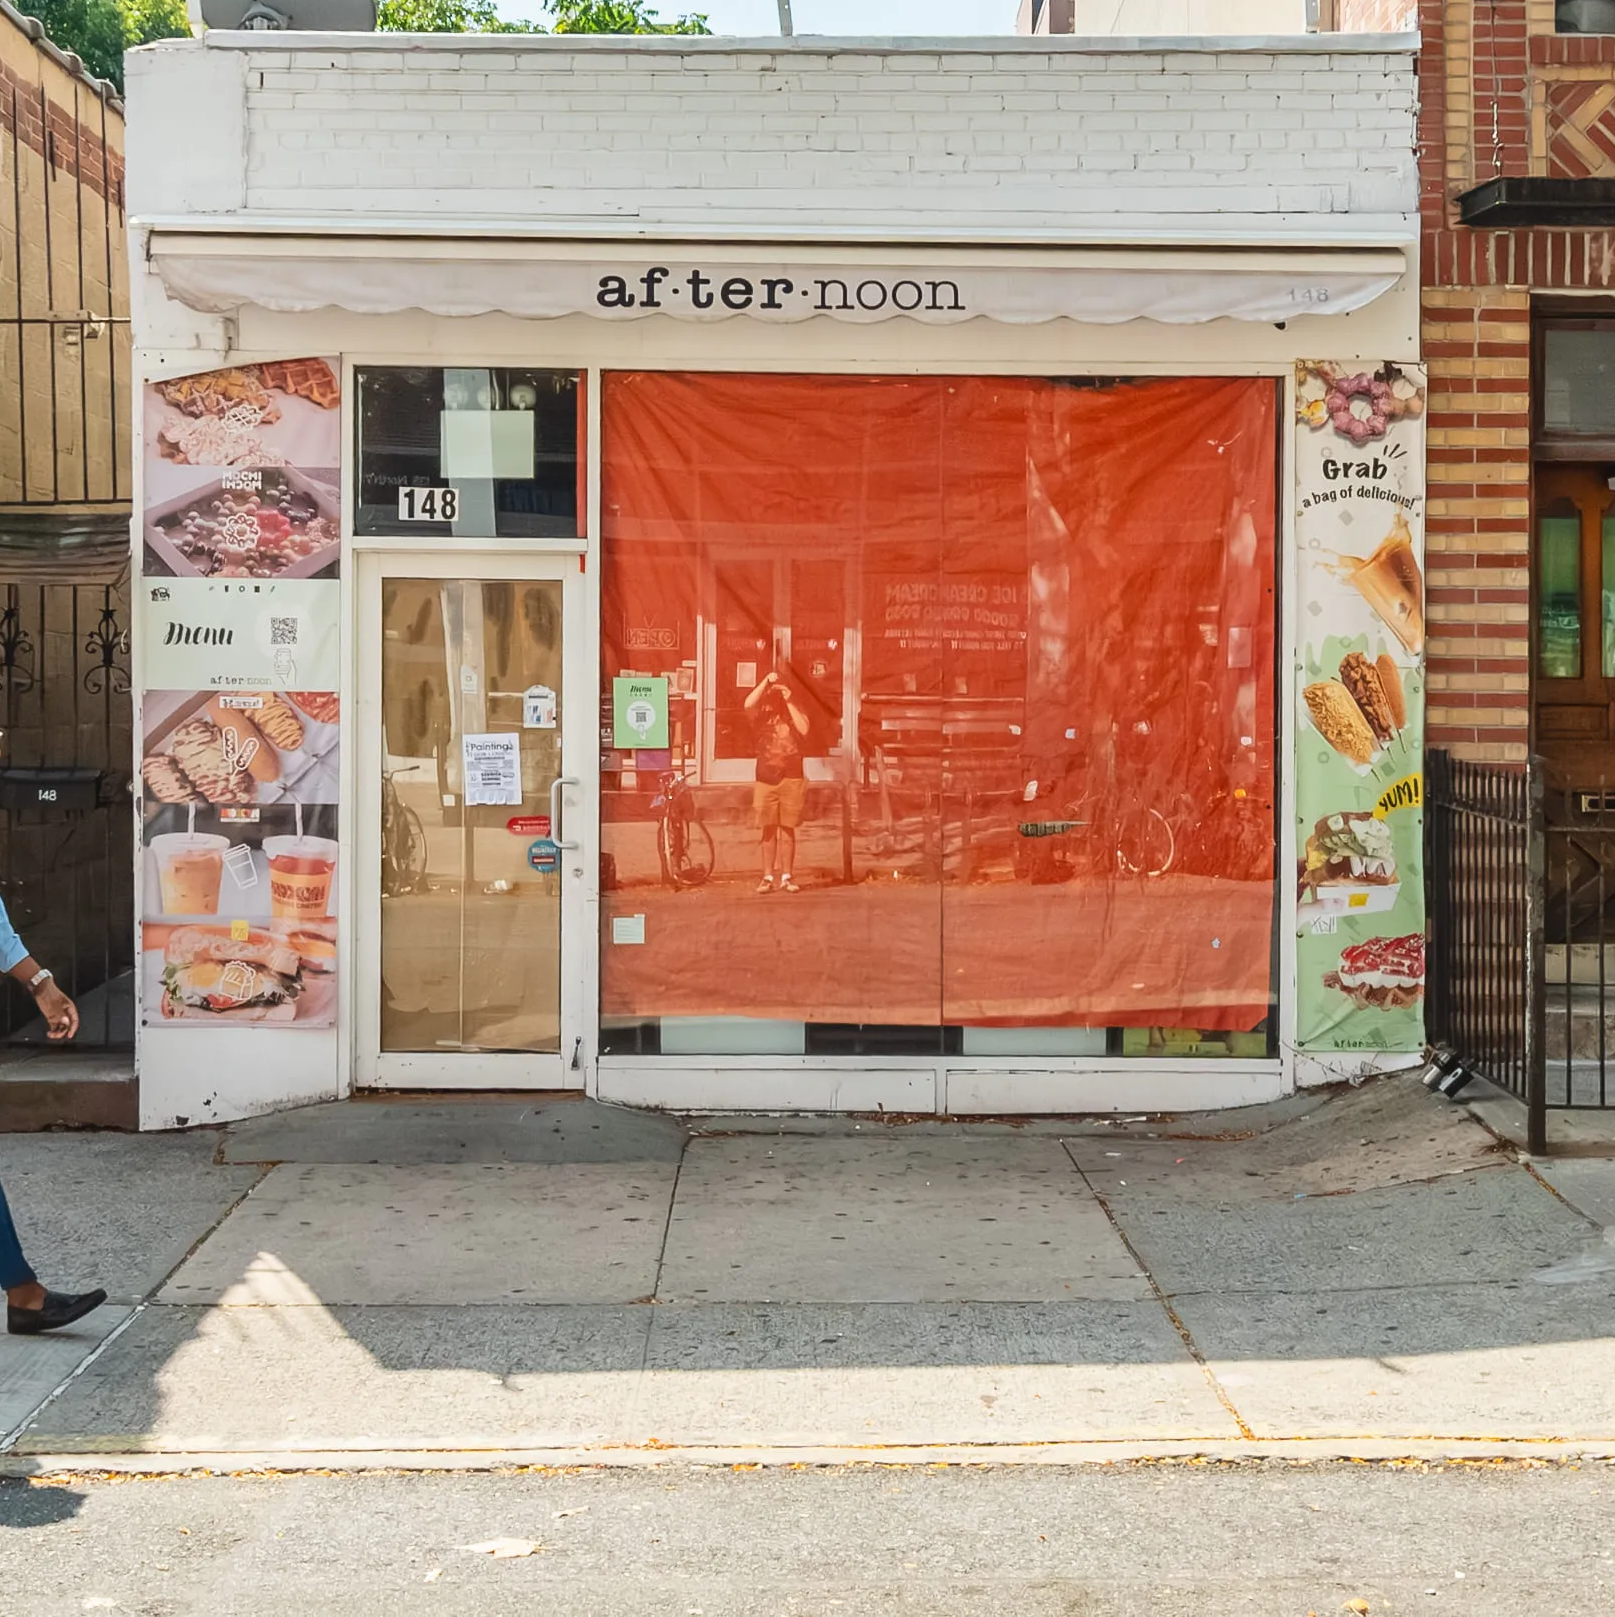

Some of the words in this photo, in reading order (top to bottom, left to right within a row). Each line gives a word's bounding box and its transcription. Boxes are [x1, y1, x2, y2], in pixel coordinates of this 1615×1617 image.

[1288, 288, 1329, 303] 148
[1323, 457, 1388, 480] Grab
[404, 489, 456, 520] 148
[1302, 498, 1311, 508] a
[1312, 490, 1337, 505] bag
[1340, 485, 1353, 499] of
[1356, 485, 1416, 510] delicious!
[38, 789, 57, 801] 148
[1379, 778, 1421, 812] YUM!
